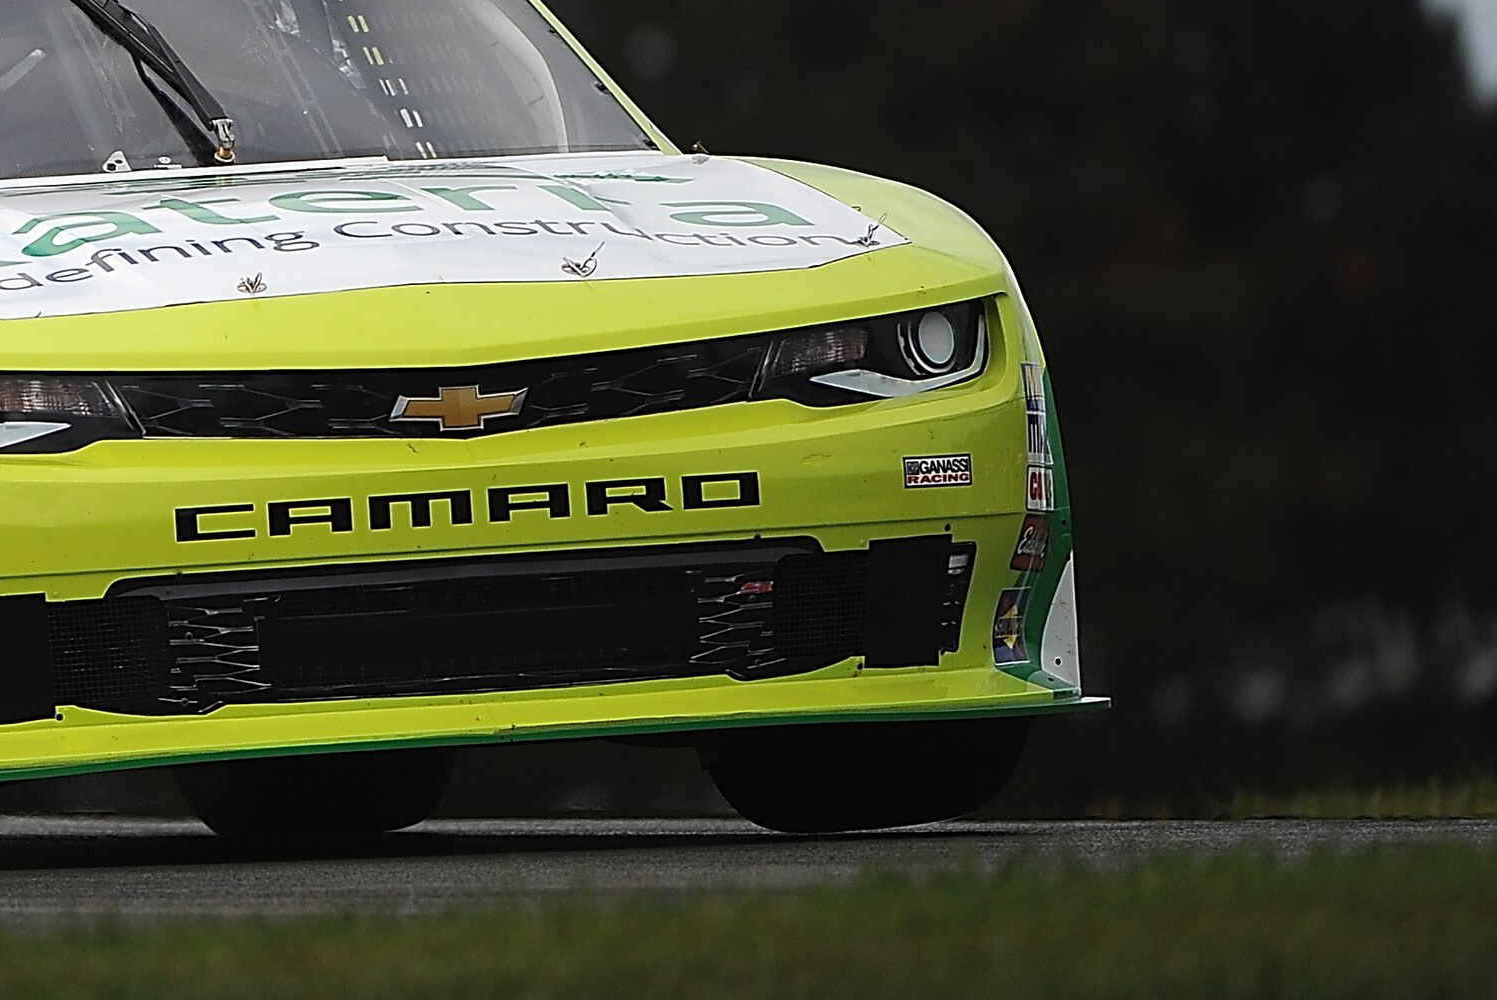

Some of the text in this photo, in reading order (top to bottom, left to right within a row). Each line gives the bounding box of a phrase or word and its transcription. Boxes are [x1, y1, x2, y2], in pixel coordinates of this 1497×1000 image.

[332, 217, 870, 248] Construction
[907, 473, 969, 484] RACING
[174, 471, 761, 543] CAMARO
